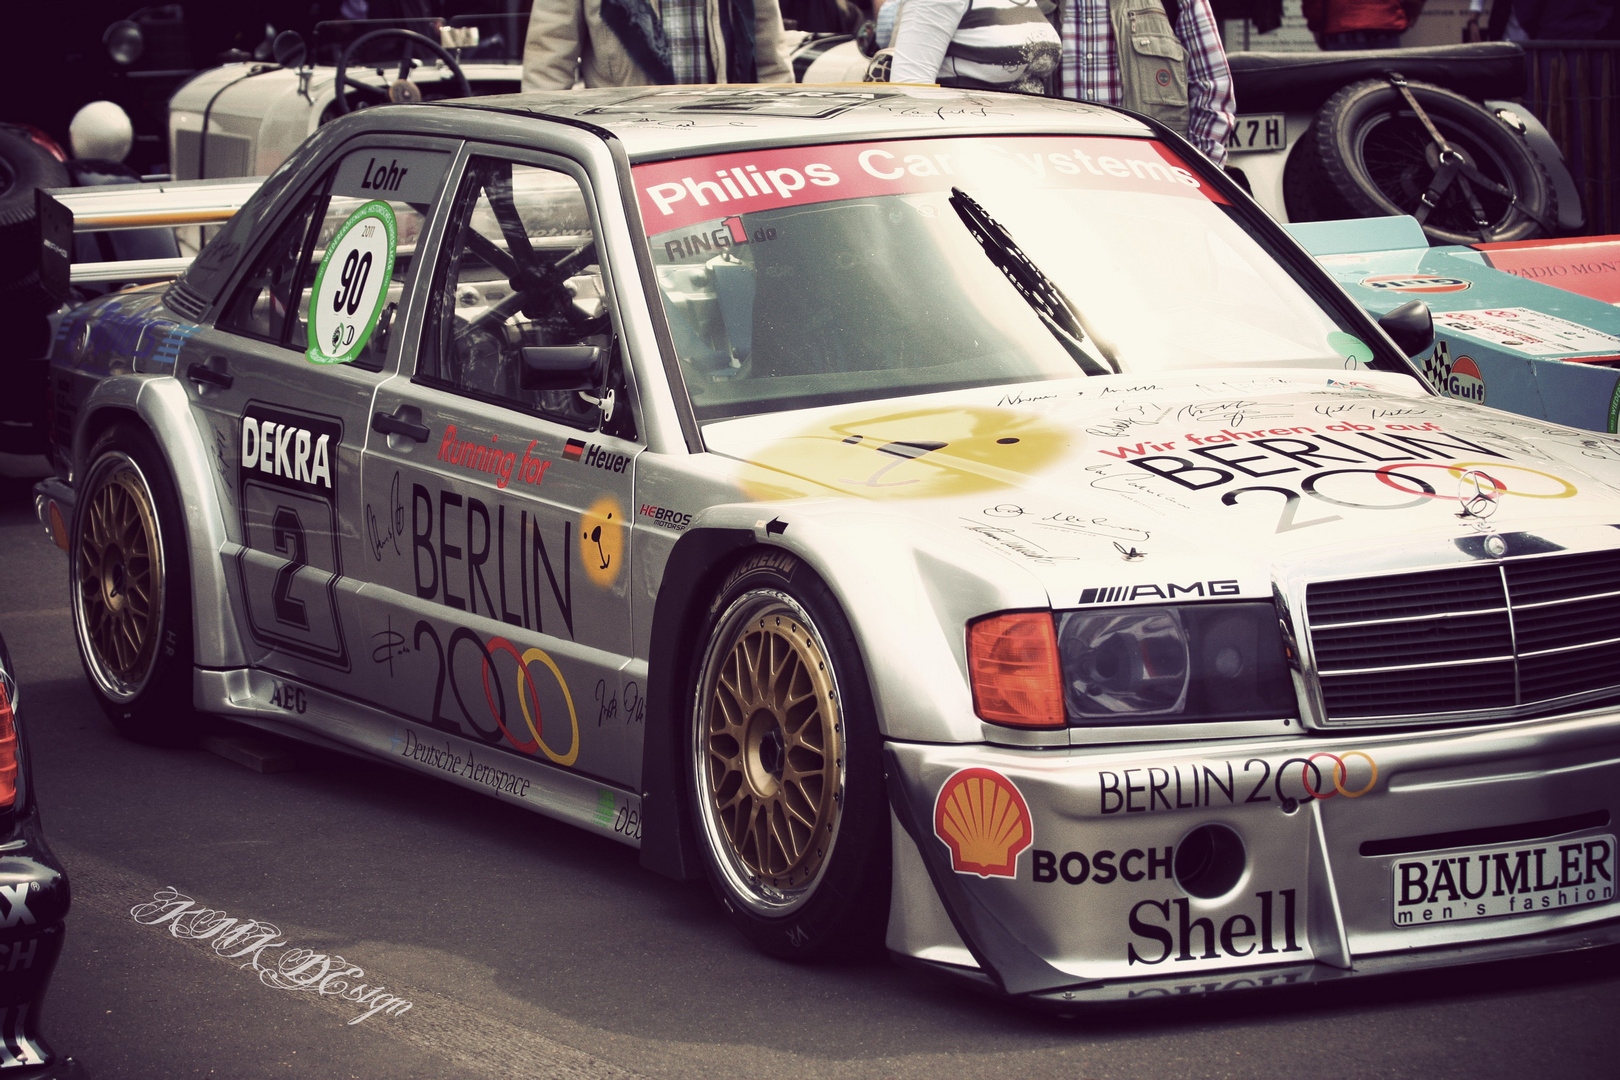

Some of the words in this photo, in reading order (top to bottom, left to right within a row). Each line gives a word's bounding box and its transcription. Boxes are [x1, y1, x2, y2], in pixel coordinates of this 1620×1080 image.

[1225, 119, 1279, 147] K7H
[361, 157, 409, 191] Lohr
[645, 163, 840, 216] Philips
[858, 149, 954, 180] Car
[361, 225, 376, 238] 2011
[664, 215, 778, 262] RING1.de
[333, 248, 373, 316] 90
[1449, 375, 1484, 401] Gulf
[241, 416, 332, 489] DEKRA
[437, 424, 518, 489] Running
[517, 439, 552, 485] for
[584, 443, 632, 474] Heuer
[1097, 441, 1177, 460] Wir
[1184, 424, 1317, 445] fahren
[1325, 421, 1376, 432] ab
[1384, 422, 1446, 433] auf
[1127, 431, 1514, 491] BERLIN
[639, 503, 693, 526] HEBROS
[1221, 461, 1579, 535] 2000
[271, 504, 311, 632] 2
[412, 482, 575, 642] BERLIN
[1129, 580, 1241, 602] AMG
[269, 679, 307, 715] AEG
[413, 619, 580, 768] 2000
[402, 728, 462, 774] Deutsche
[460, 750, 531, 798] Aerospace
[1099, 760, 1235, 815] BERLIN
[1243, 750, 1379, 805] 2000
[1032, 845, 1174, 886] BOSCH
[1398, 839, 1612, 907] BÄUMLER
[1127, 888, 1303, 967] Shell
[1398, 901, 1487, 924] men's
[1509, 885, 1613, 912] fashion
